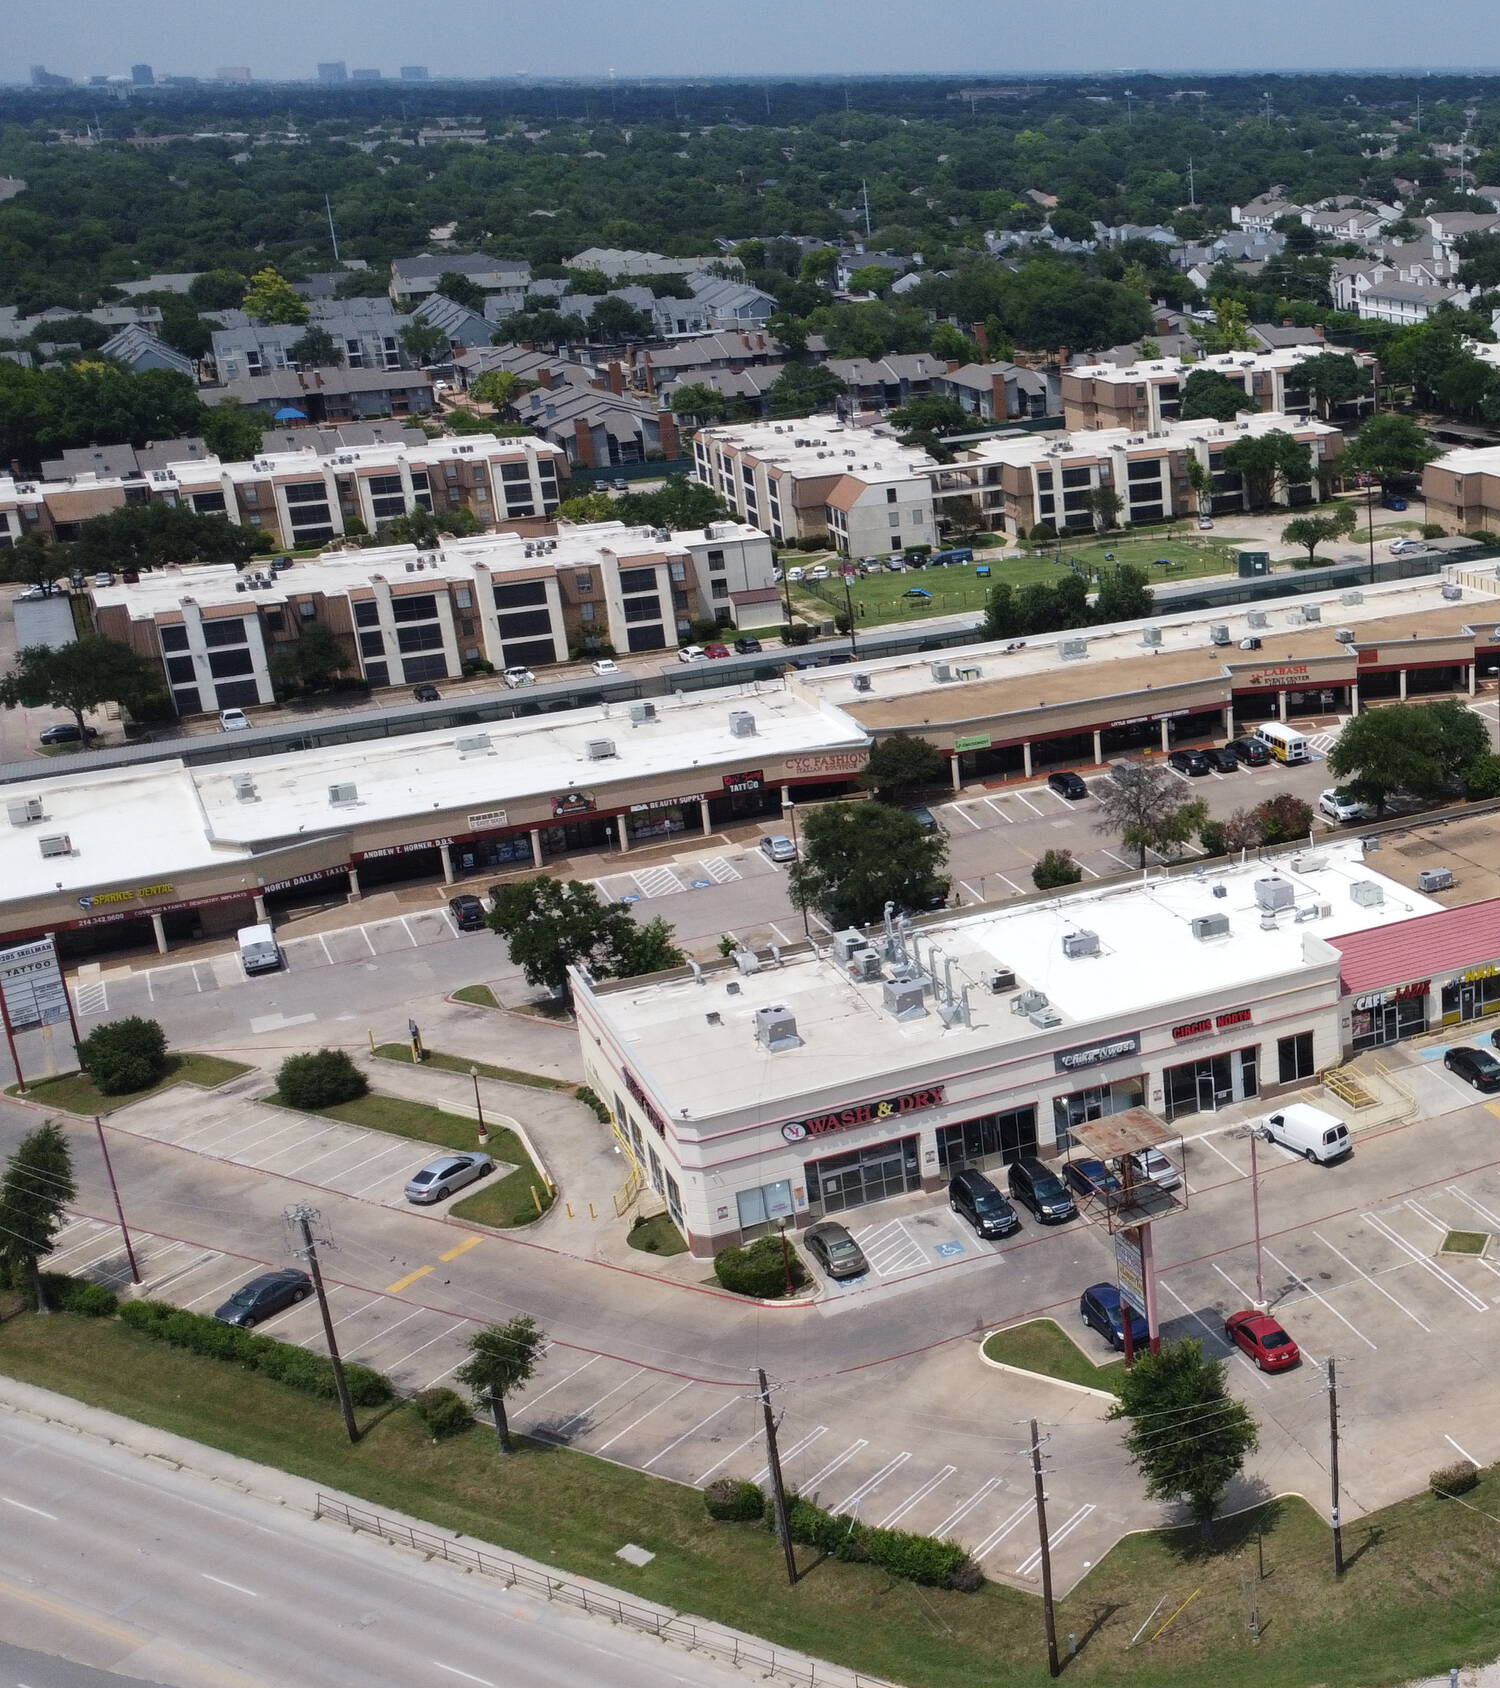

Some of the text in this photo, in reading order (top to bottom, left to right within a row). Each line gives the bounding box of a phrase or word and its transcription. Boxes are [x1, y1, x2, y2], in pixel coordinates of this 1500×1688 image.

[785, 752, 868, 770] CYC FASHION
[649, 798, 678, 809] BEAUTY
[679, 793, 705, 804] SUPPLY
[363, 847, 395, 860] ANDREW
[263, 864, 350, 893] NORTH DALLAS TAXES
[92, 888, 134, 905] SPARKLE
[138, 882, 174, 899] DENTAL
[17, 943, 53, 958] SKILLMAN
[5, 960, 51, 977] TATTOO
[1356, 992, 1388, 1011] CAFE
[1172, 1009, 1251, 1040] CIRCUS NORTH
[805, 1086, 945, 1134] WASH & DRY
